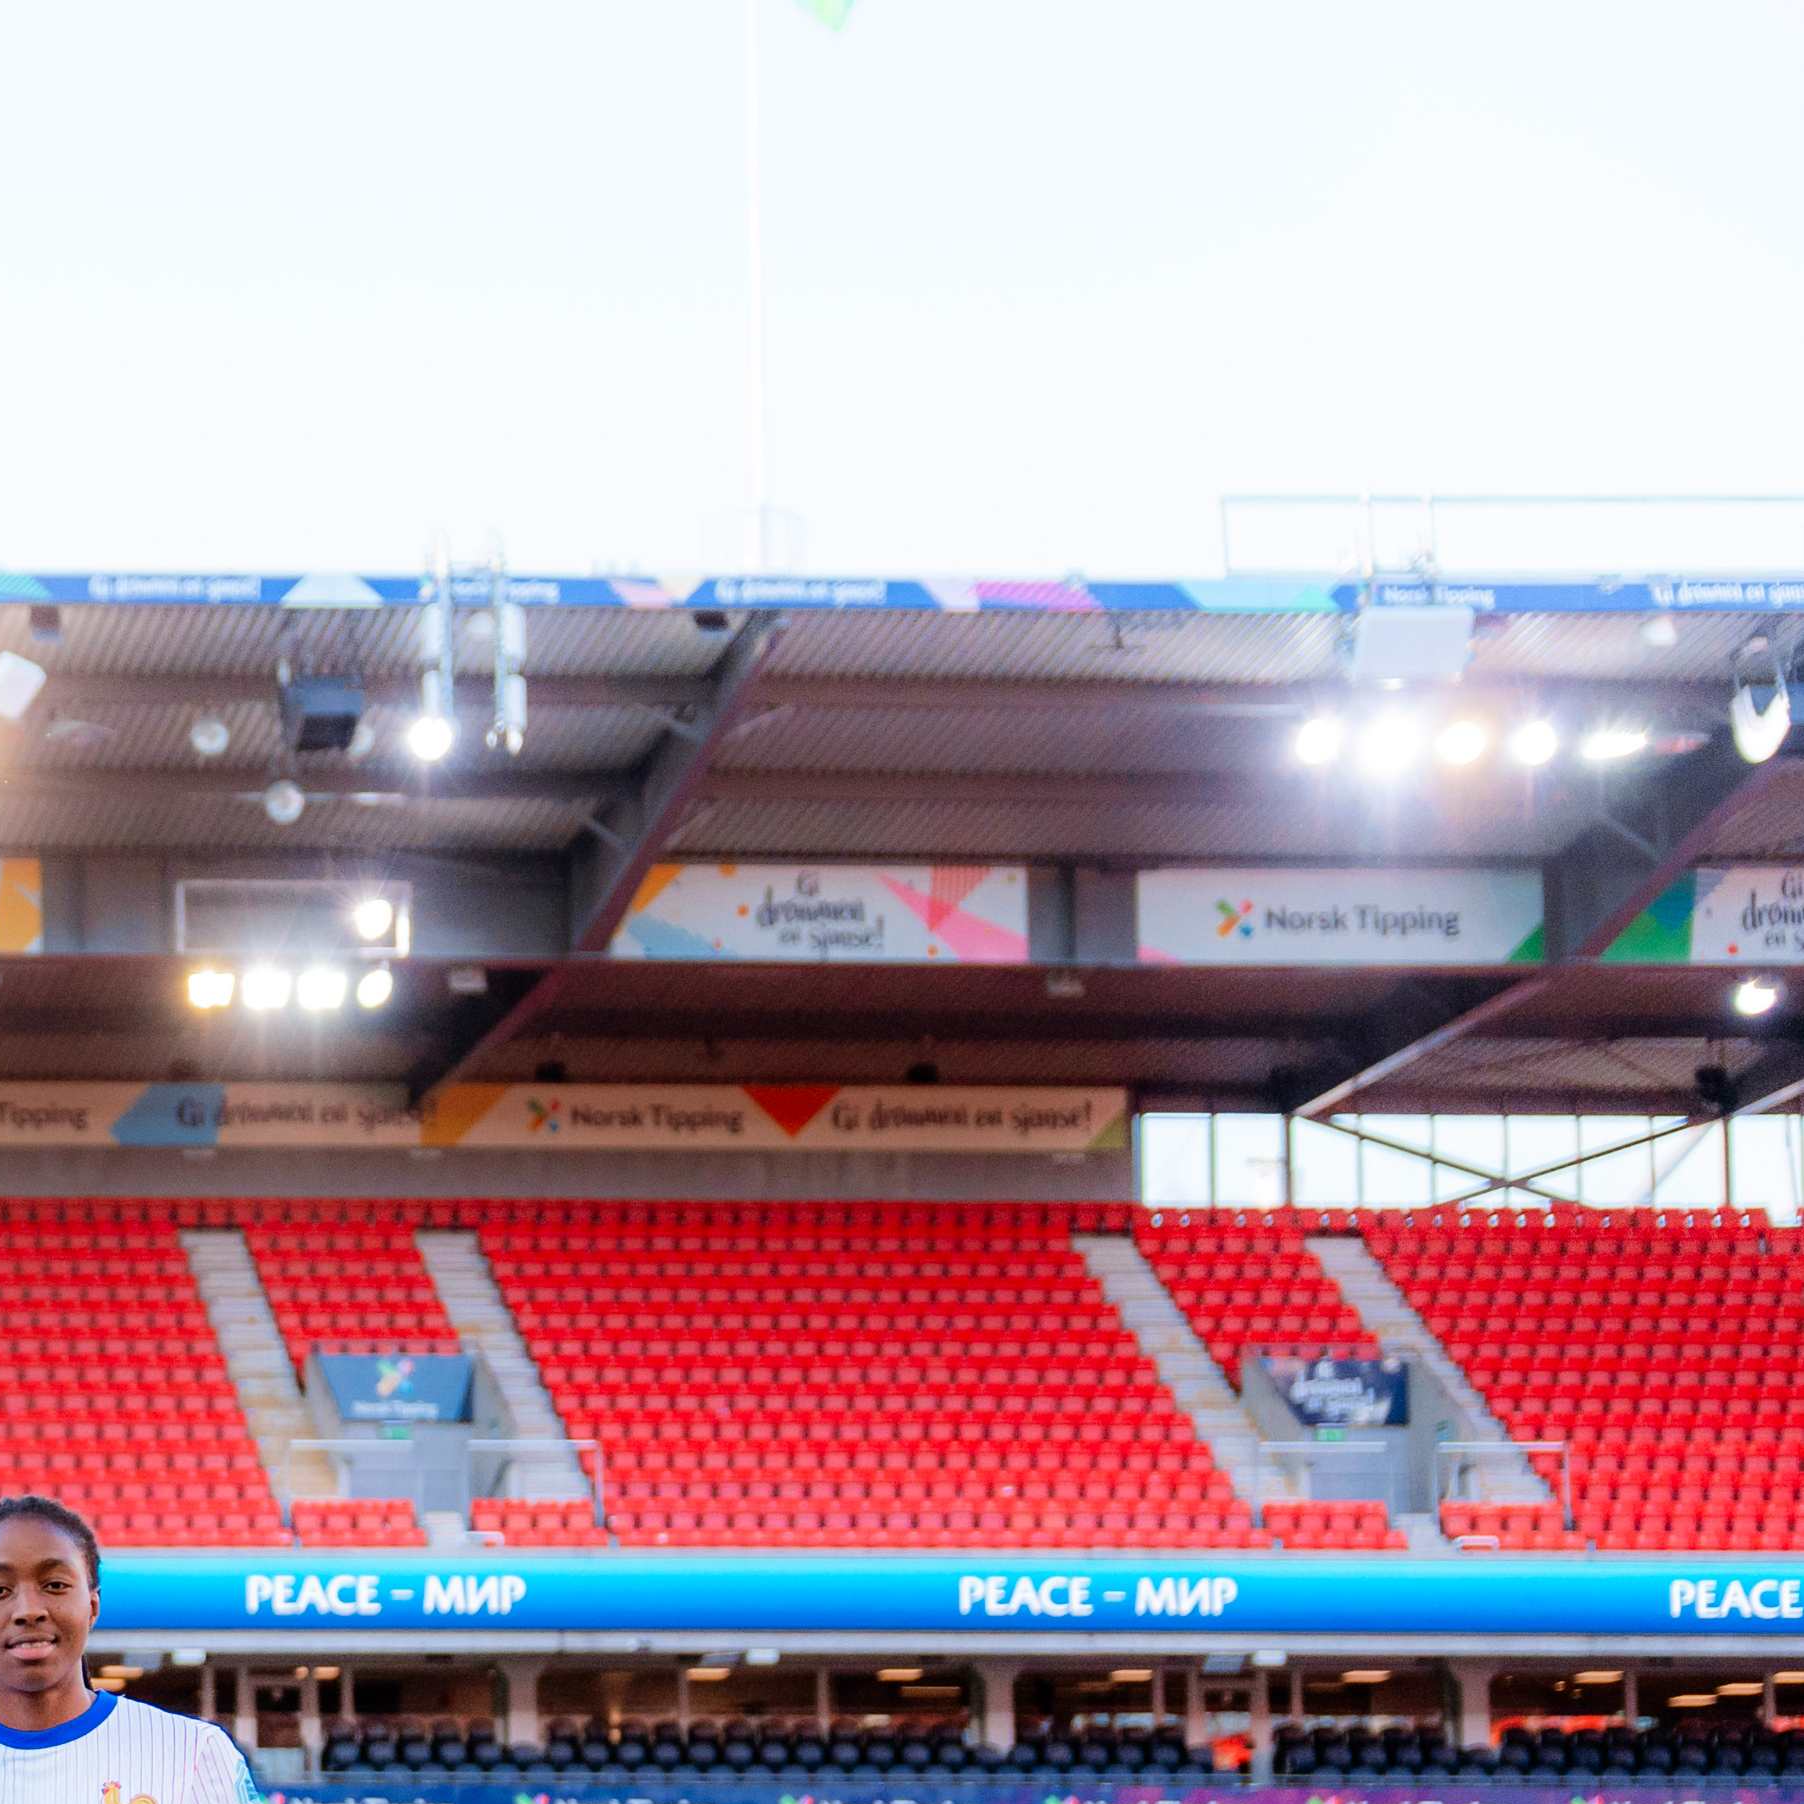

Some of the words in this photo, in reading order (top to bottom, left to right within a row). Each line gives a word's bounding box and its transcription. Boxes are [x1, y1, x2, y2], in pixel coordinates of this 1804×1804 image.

[1264, 906, 1350, 930] Norsk
[1355, 905, 1460, 937] Tipping
[571, 1103, 646, 1127] Norsk
[652, 1103, 742, 1133] Tipping
[246, 1575, 381, 1615] PEACE
[423, 1575, 527, 1615] МИР
[958, 1577, 1093, 1616] PEACE
[1135, 1577, 1237, 1617] МИР
[1669, 1579, 1804, 1619] PEACE
